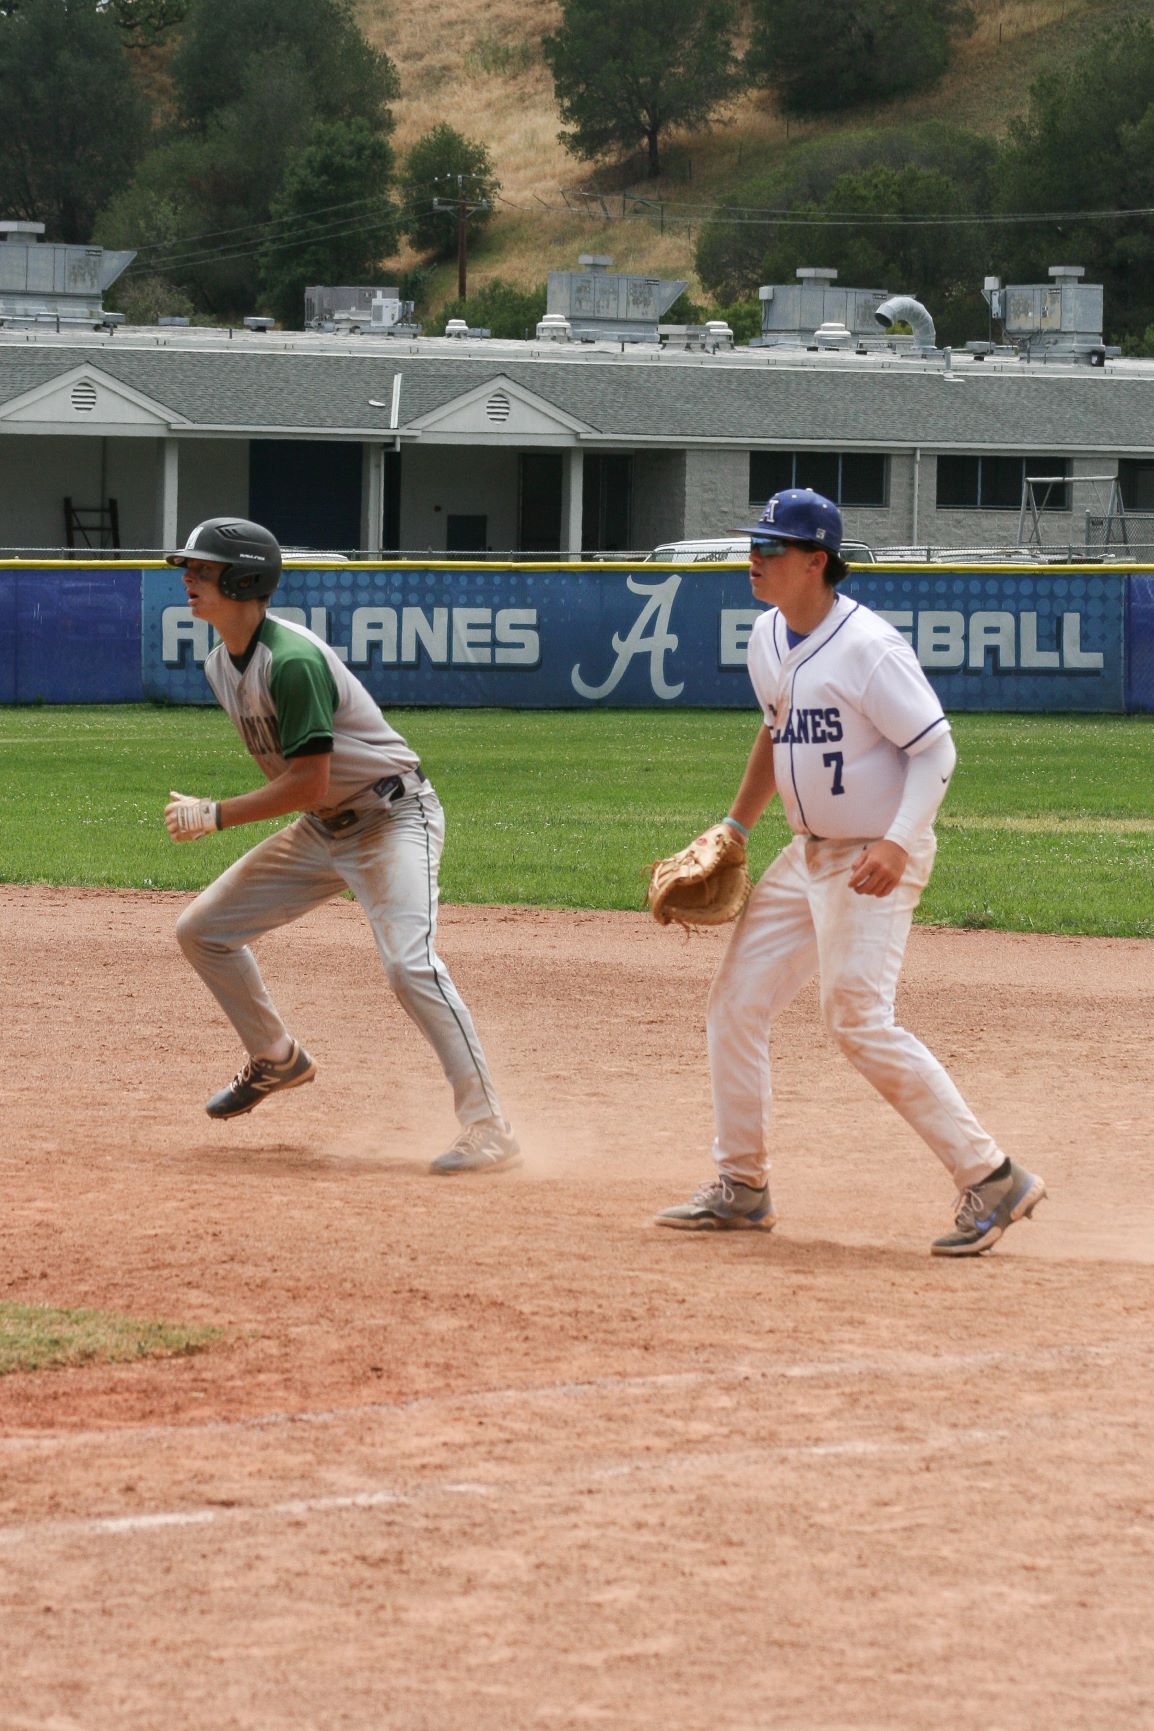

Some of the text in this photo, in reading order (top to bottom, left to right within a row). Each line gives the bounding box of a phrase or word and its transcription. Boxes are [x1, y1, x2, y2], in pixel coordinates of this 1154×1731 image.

[162, 606, 540, 665] ALANES
[571, 574, 684, 700] A
[720, 609, 1104, 669] BBALL
[823, 751, 844, 795] 7
